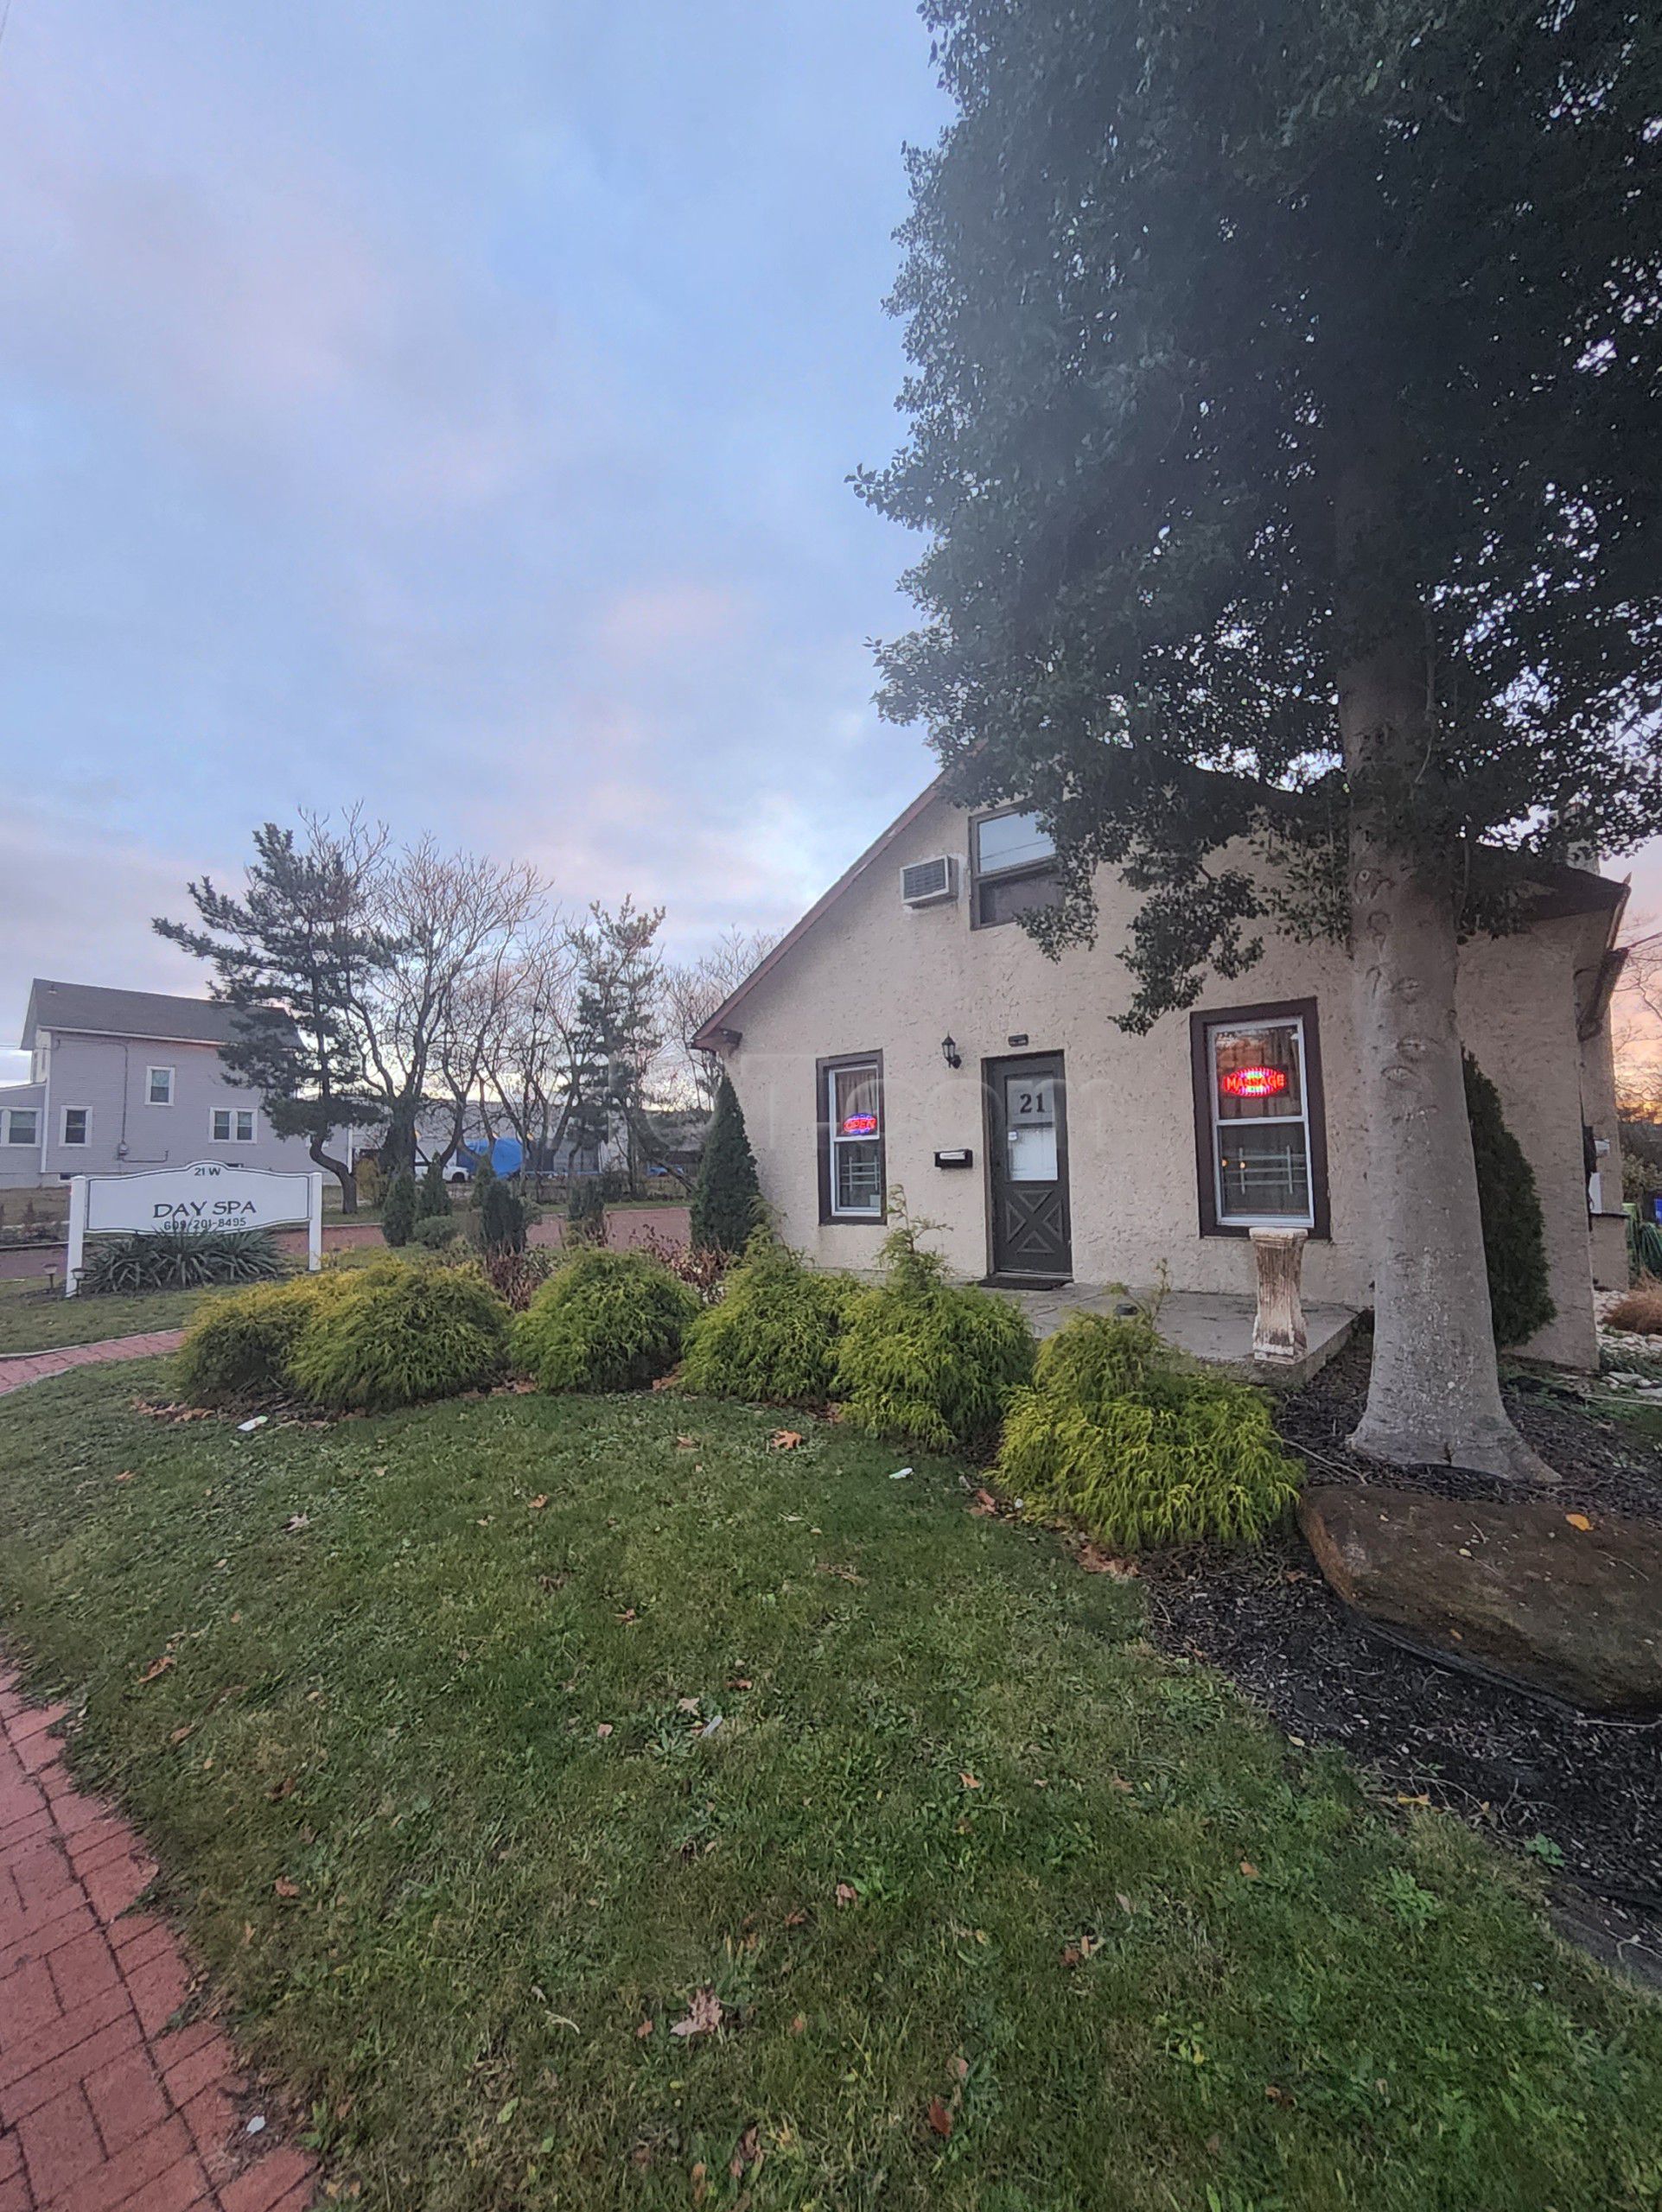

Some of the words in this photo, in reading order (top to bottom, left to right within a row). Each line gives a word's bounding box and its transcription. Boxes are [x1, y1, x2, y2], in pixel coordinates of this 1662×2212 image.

[1226, 1073, 1285, 1091] MASSAGE
[1020, 1093, 1045, 1113] 21
[844, 1117, 876, 1131] OPEN
[194, 1167, 205, 1176] 21
[209, 1167, 221, 1176] W
[153, 1201, 207, 1218] DAY
[213, 1201, 257, 1215] SPA
